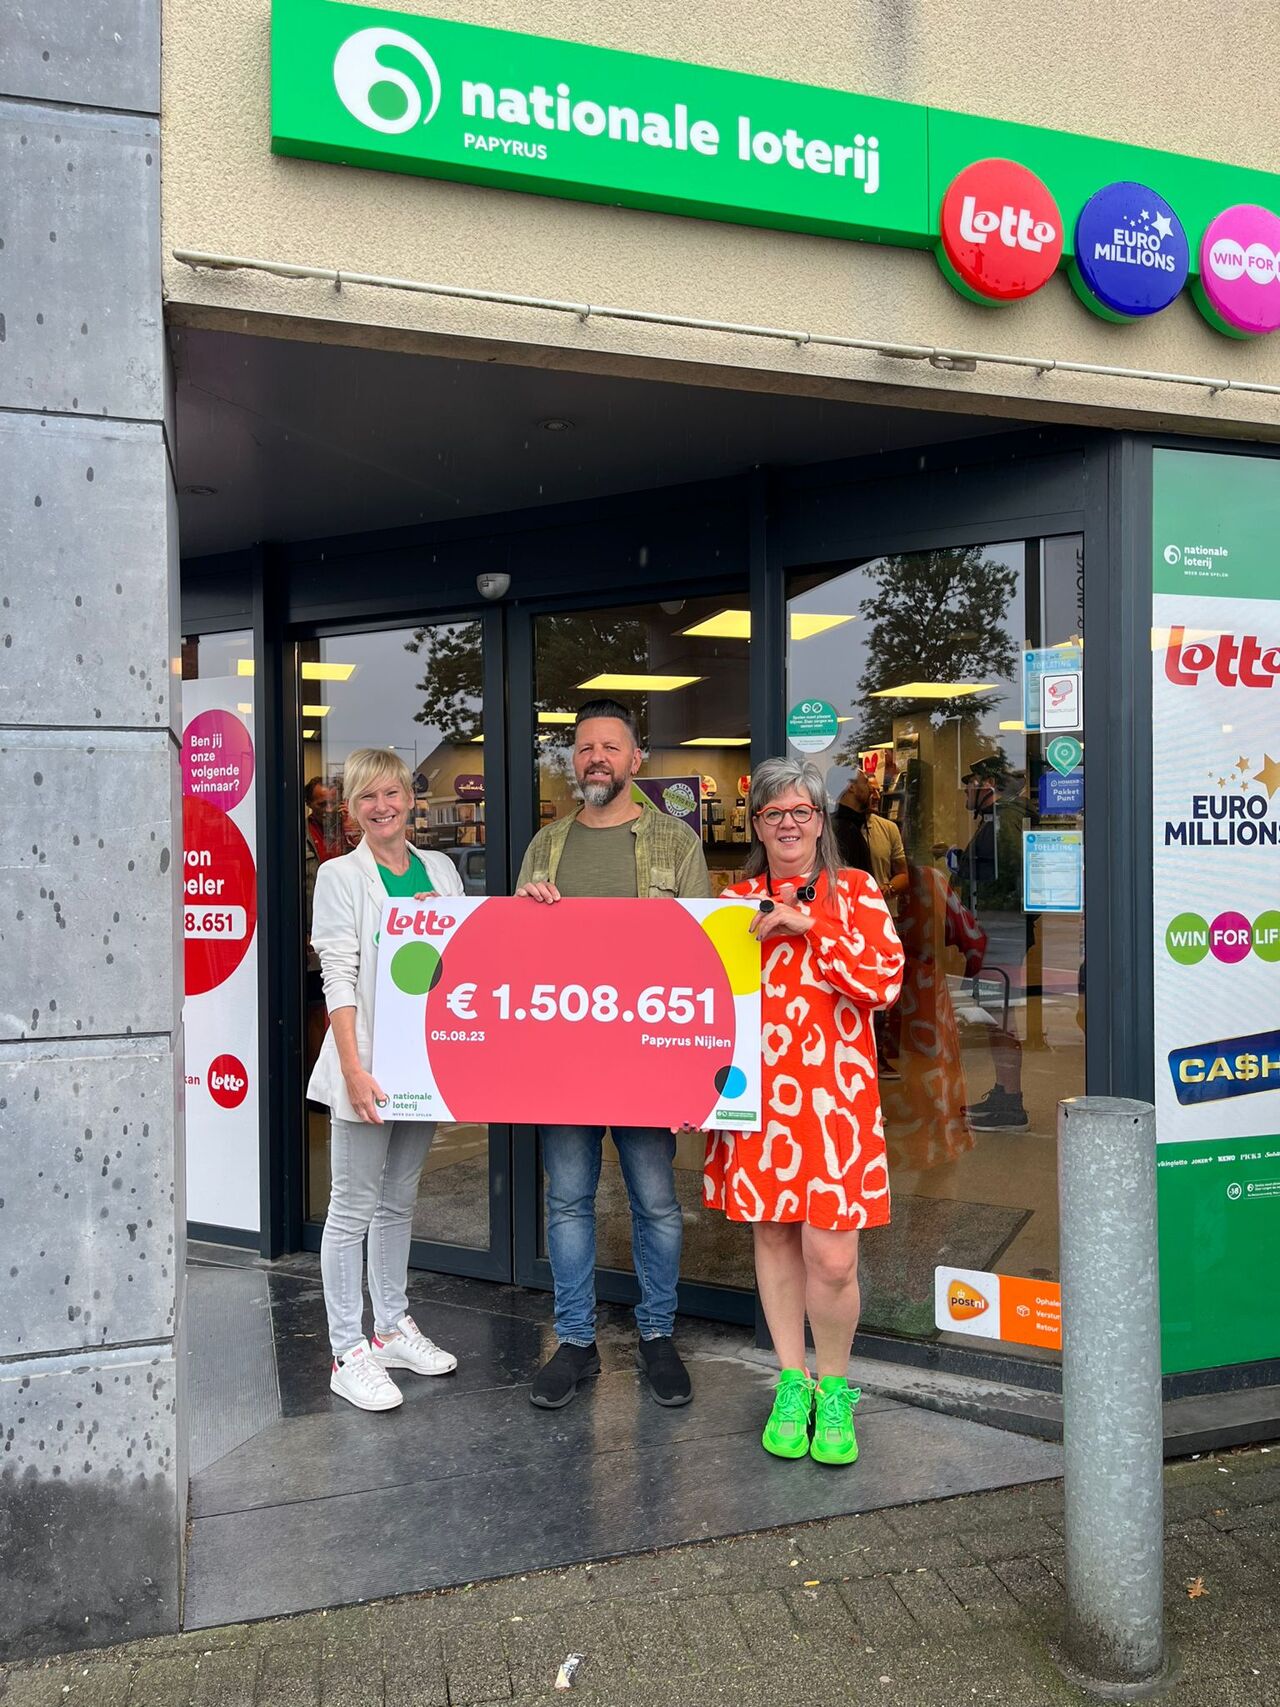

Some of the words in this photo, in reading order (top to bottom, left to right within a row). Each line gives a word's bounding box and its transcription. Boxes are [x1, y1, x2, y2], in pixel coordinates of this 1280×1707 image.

[461, 79, 720, 156] nationale
[738, 116, 880, 194] loterij
[463, 132, 548, 160] PAPYRUS
[1113, 229, 1161, 250] EURO
[1094, 243, 1176, 273] MILLIONS
[1213, 252, 1243, 266] WIN
[1248, 255, 1274, 271] FOR
[1184, 545, 1229, 557] nationale
[1184, 556, 1212, 570] loterij
[191, 735, 210, 747] Ben
[212, 733, 222, 749] jij
[191, 752, 216, 763] onze
[191, 764, 240, 780] volgende
[191, 779, 240, 793] winnaar?
[1053, 788, 1080, 796] Pakket
[1193, 795, 1268, 820] EURO
[1165, 821, 1280, 846] MILLION
[184, 873, 225, 895] eler
[1170, 931, 1206, 947] WIN
[1213, 929, 1249, 946] FOR
[446, 982, 478, 1020] €
[492, 983, 714, 1025] 1.508.651
[431, 1030, 486, 1042] 05.08.23
[641, 1034, 691, 1048] Papyrus
[694, 1035, 732, 1049] Nijlen
[393, 1092, 433, 1101] nationale
[392, 1101, 418, 1112] loterij
[1036, 1322, 1059, 1332] Retour
